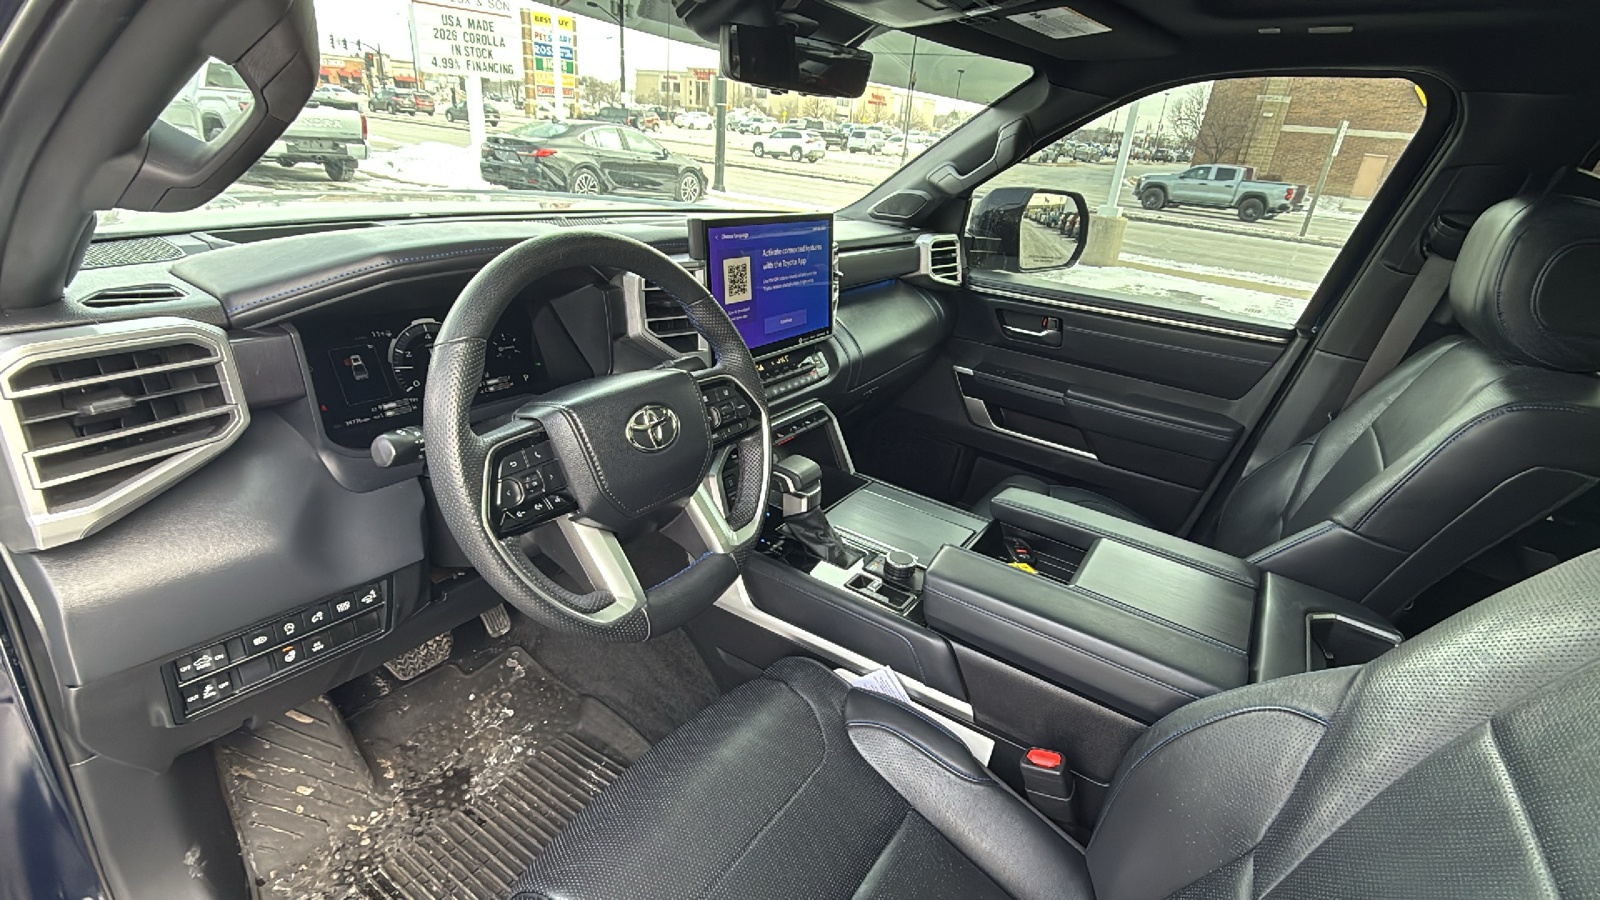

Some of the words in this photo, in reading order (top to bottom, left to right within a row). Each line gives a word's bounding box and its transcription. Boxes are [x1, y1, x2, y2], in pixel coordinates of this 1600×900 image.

[441, 14, 462, 28] USA
[468, 18, 494, 32] MADE
[433, 28, 457, 41] 2026
[463, 32, 506, 47] COROLLA
[451, 44, 462, 56] IN
[464, 46, 494, 60] STOCK
[466, 60, 514, 75] FINANCING
